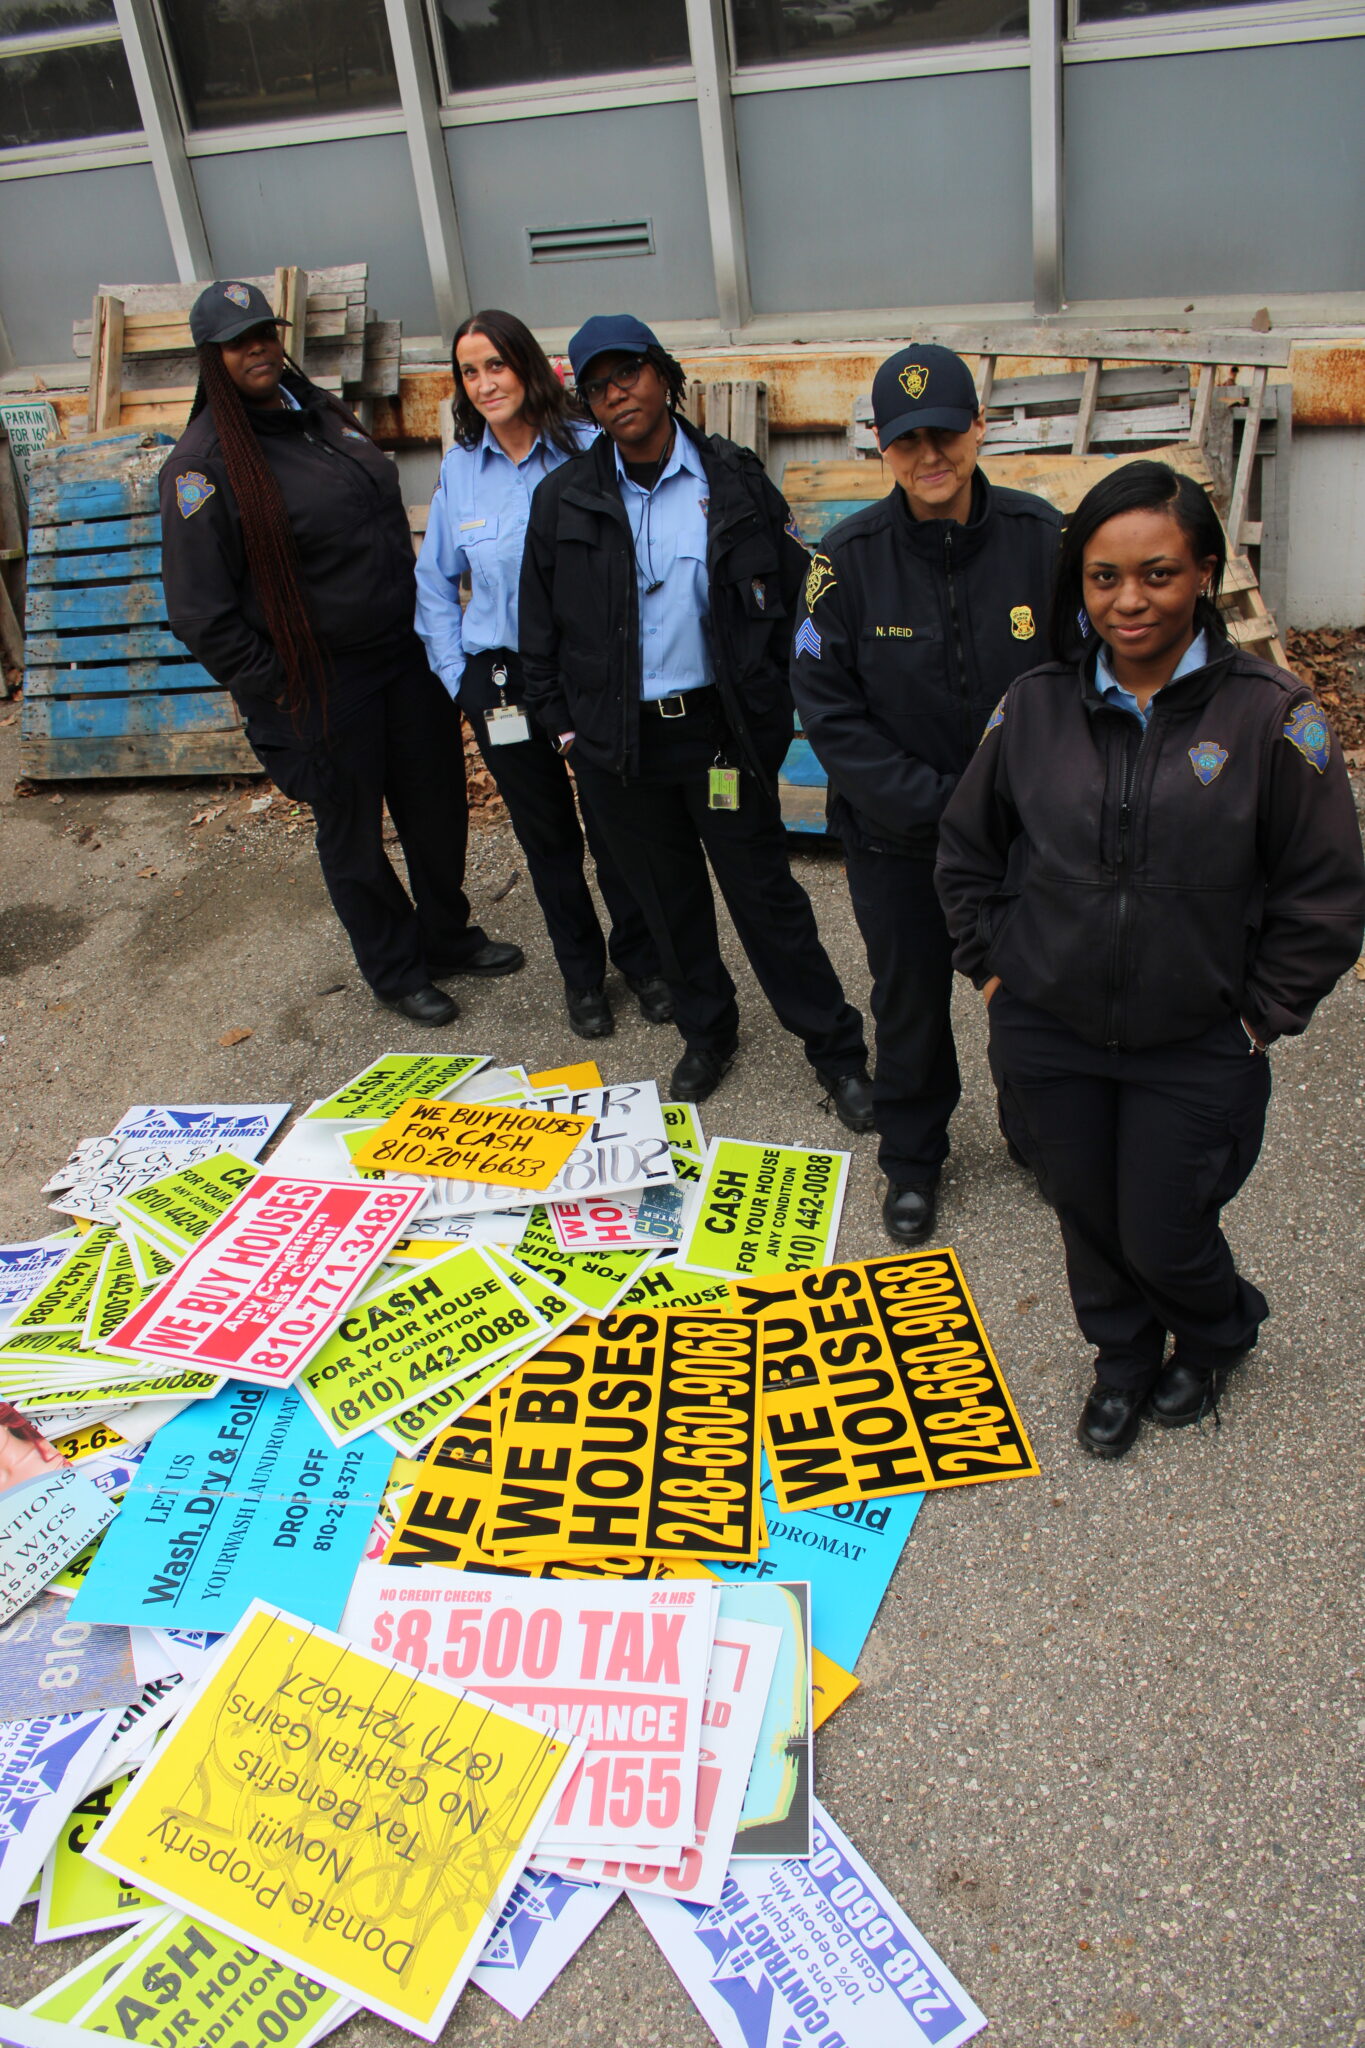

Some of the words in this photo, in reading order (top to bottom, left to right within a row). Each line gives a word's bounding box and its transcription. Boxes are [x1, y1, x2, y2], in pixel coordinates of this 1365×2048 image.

[10, 428, 29, 442] FOR
[876, 626, 886, 637] N.
[888, 627, 913, 637] REID
[344, 1104, 371, 1119] FOR
[366, 1082, 401, 1105] YOUR
[399, 1056, 434, 1081] HOUSE
[394, 1065, 440, 1097] CONDITION
[415, 1057, 475, 1096] 442-0088
[150, 1128, 218, 1139] CONTRACT
[220, 1127, 268, 1138] HOMES
[402, 1124, 449, 1141] FOR
[456, 1130, 534, 1152] CASH
[410, 1104, 447, 1121] WE
[172, 1185, 194, 1198] ANY
[189, 1196, 224, 1218] CONDIT
[178, 1169, 205, 1186] FOR
[199, 1181, 233, 1204] YOUR
[758, 1149, 781, 1194] HOUSE
[773, 1166, 797, 1228] CONDITION
[795, 1154, 833, 1231] 442-0088
[127, 1186, 175, 1213] (810)
[165, 1206, 213, 1238] 442-00
[744, 1198, 768, 1237] YOUR
[139, 1315, 214, 1351] WE
[177, 1267, 251, 1317] BUY
[218, 1183, 324, 1268] HOUSES
[223, 1296, 263, 1334] Any
[257, 1212, 331, 1297] Condition
[252, 1283, 298, 1325] Fast
[290, 1224, 341, 1277] Cash!
[517, 1242, 574, 1268] YOUR
[581, 1260, 628, 1283] FOR
[736, 1242, 759, 1273] FOR
[766, 1231, 783, 1258] ANY
[22, 1262, 91, 1326] 442-0088
[250, 1193, 408, 1368] 810-771-3488
[306, 1354, 356, 1389] FOR
[357, 1319, 423, 1361] YOUR
[423, 1277, 502, 1327] HOUSE
[347, 1360, 384, 1389] ANY
[388, 1306, 488, 1363] CONDITION
[736, 1285, 820, 1394] BUY
[330, 1375, 406, 1431] (810)
[408, 1307, 531, 1385] 442-0088
[801, 1268, 926, 1492] HOUSES
[873, 1260, 1024, 1473] 248-660-9068
[217, 1389, 265, 1441] Fold
[567, 1312, 660, 1547] HOUSES
[654, 1321, 753, 1549] 248-660-9068
[208, 1449, 237, 1465] &
[247, 1396, 300, 1501] LAUNDROMAT
[767, 1405, 849, 1504] WE
[145, 1485, 181, 1525] LET
[166, 1454, 195, 1481] US
[184, 1470, 232, 1515] Dry
[272, 1490, 312, 1548] DROP
[299, 1448, 329, 1487] OFF
[312, 1450, 364, 1552] 810-228-3712
[491, 1446, 573, 1542] WE
[832, 1499, 892, 1531] old
[16, 1502, 77, 1558] WIGS
[40, 1561, 60, 1581] Rd
[62, 1527, 96, 1559] Flint
[98, 1508, 115, 1525] Mi
[142, 1524, 211, 1605] Wash,
[380, 1588, 397, 1602] NO
[398, 1589, 443, 1603] CREDIT
[443, 1590, 493, 1604] CHECKS
[649, 1592, 668, 1605] 24
[668, 1591, 696, 1606] HRS
[578, 1609, 687, 1686] TAX
[226, 1692, 313, 1752] Gains
[276, 1671, 408, 1749] 721-1627
[314, 1736, 430, 1806] Capital
[419, 1724, 504, 1787] (877)
[232, 1749, 363, 1831] Benefits
[438, 1791, 490, 1835] No
[147, 1815, 286, 1911] Property
[365, 1812, 421, 1863] Tax
[769, 1866, 796, 1903] Min.
[292, 1891, 416, 1976] Donate
[757, 1892, 797, 1944] Equity
[788, 1903, 840, 1969] Deposit
[814, 1899, 853, 1949] Deals
[196, 1943, 260, 2010] HOU
[734, 1911, 831, 2037] CONTRACT
[790, 1945, 809, 1961] of
[850, 1949, 885, 1994] Cash
[807, 1963, 838, 2007] Tons
[839, 1965, 866, 2006] 10%
